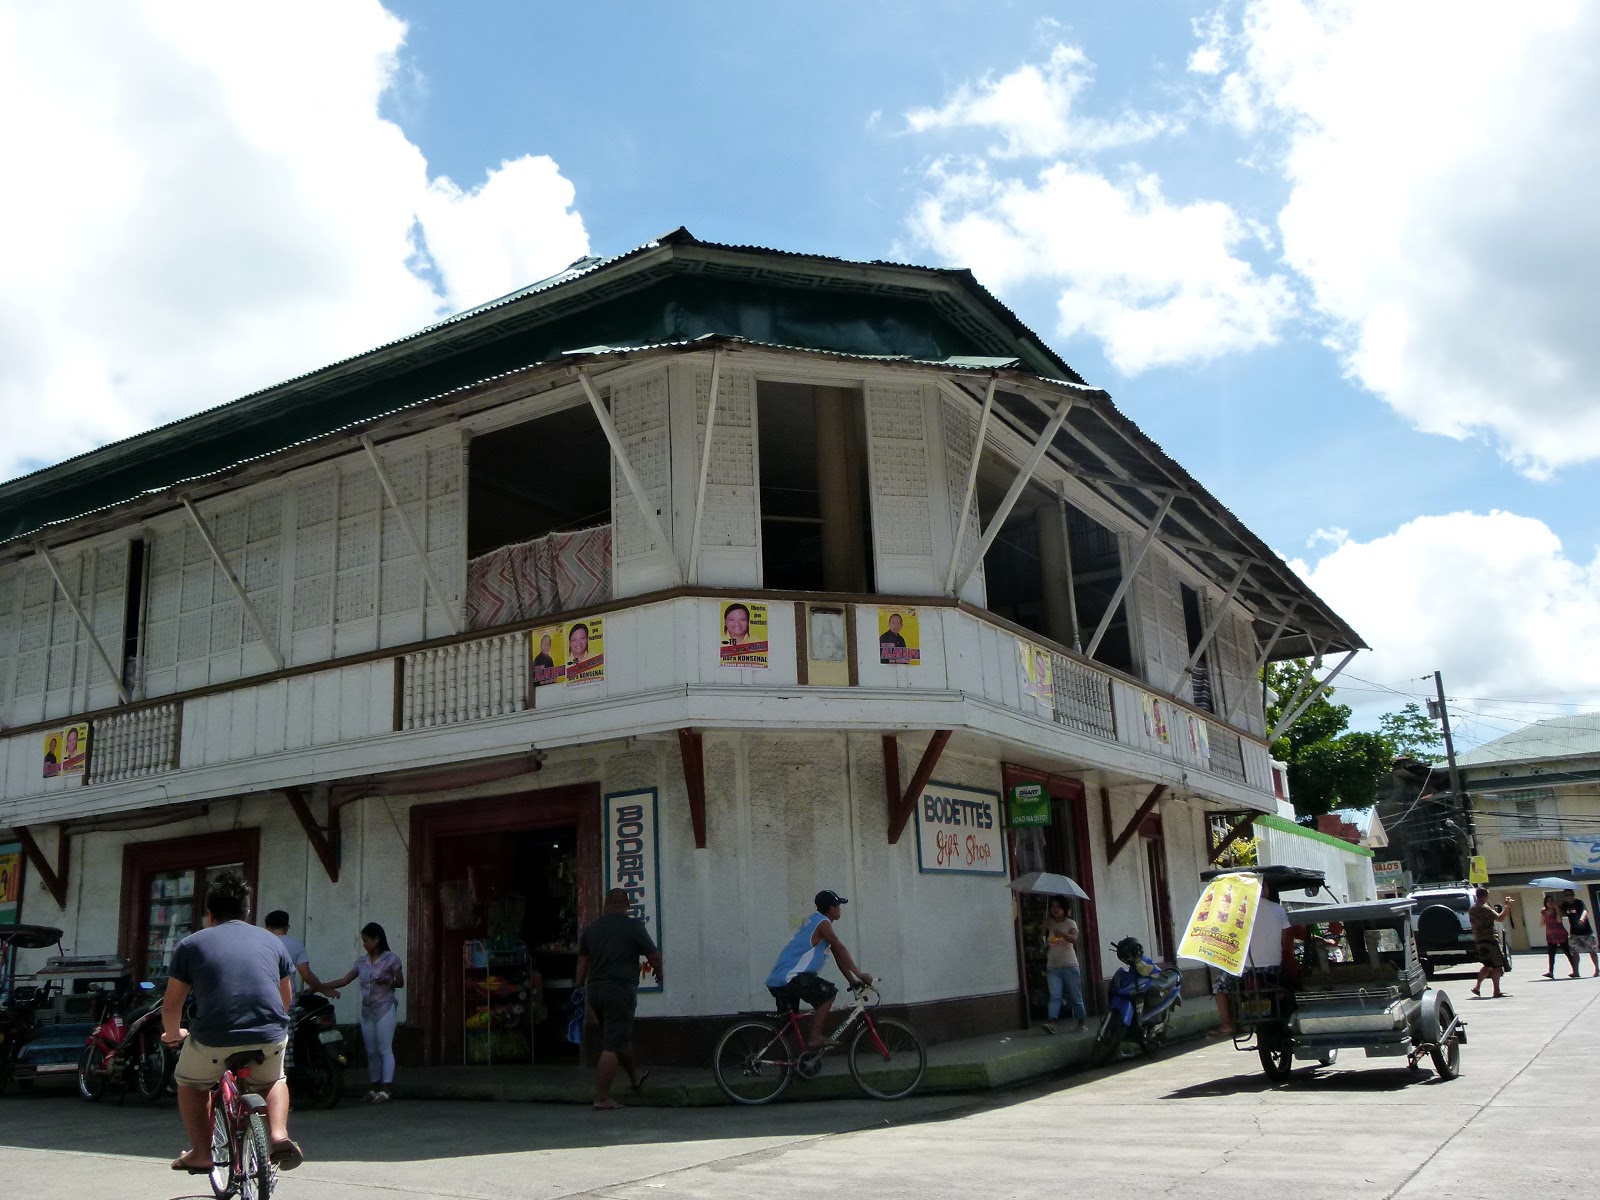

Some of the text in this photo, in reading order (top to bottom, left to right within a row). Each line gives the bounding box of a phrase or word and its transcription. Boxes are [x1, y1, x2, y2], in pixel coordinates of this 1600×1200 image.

[924, 795, 993, 829] BODETTE'S
[936, 830, 992, 867] Gift Shop
